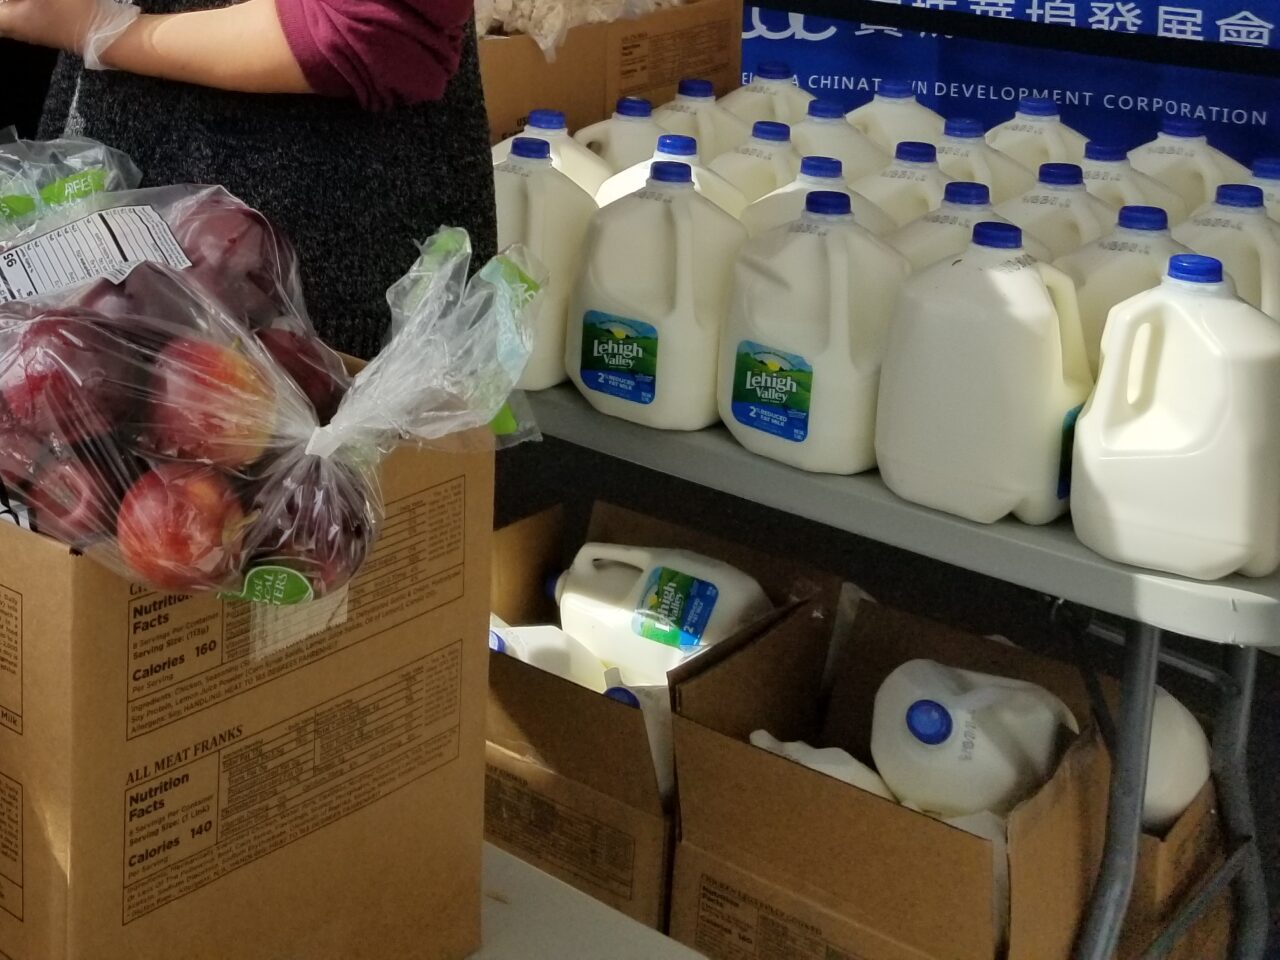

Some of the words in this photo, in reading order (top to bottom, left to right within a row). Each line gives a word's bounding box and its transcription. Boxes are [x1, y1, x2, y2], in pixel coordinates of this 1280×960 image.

[808, 74, 928, 95] CHINATN
[934, 82, 1094, 106] DEVELOPMENT
[1103, 93, 1268, 126] CORPORATION
[2, 252, 17, 269] 95
[593, 340, 643, 358] Lehigh
[603, 353, 636, 369] Valley
[746, 371, 798, 392] Lehigh
[756, 386, 789, 403] Valley
[133, 584, 192, 620] Nutritio
[133, 609, 169, 635] Facts
[132, 650, 184, 685] Calories
[196, 638, 216, 658] 160
[1, 709, 17, 727] Milk
[126, 764, 149, 785] ALL
[154, 746, 189, 774] MEAT
[193, 723, 243, 757] FRANKS
[129, 769, 189, 808] Nutrition
[129, 795, 164, 823] Facts
[128, 833, 180, 869] Calories
[190, 819, 212, 840] 140
